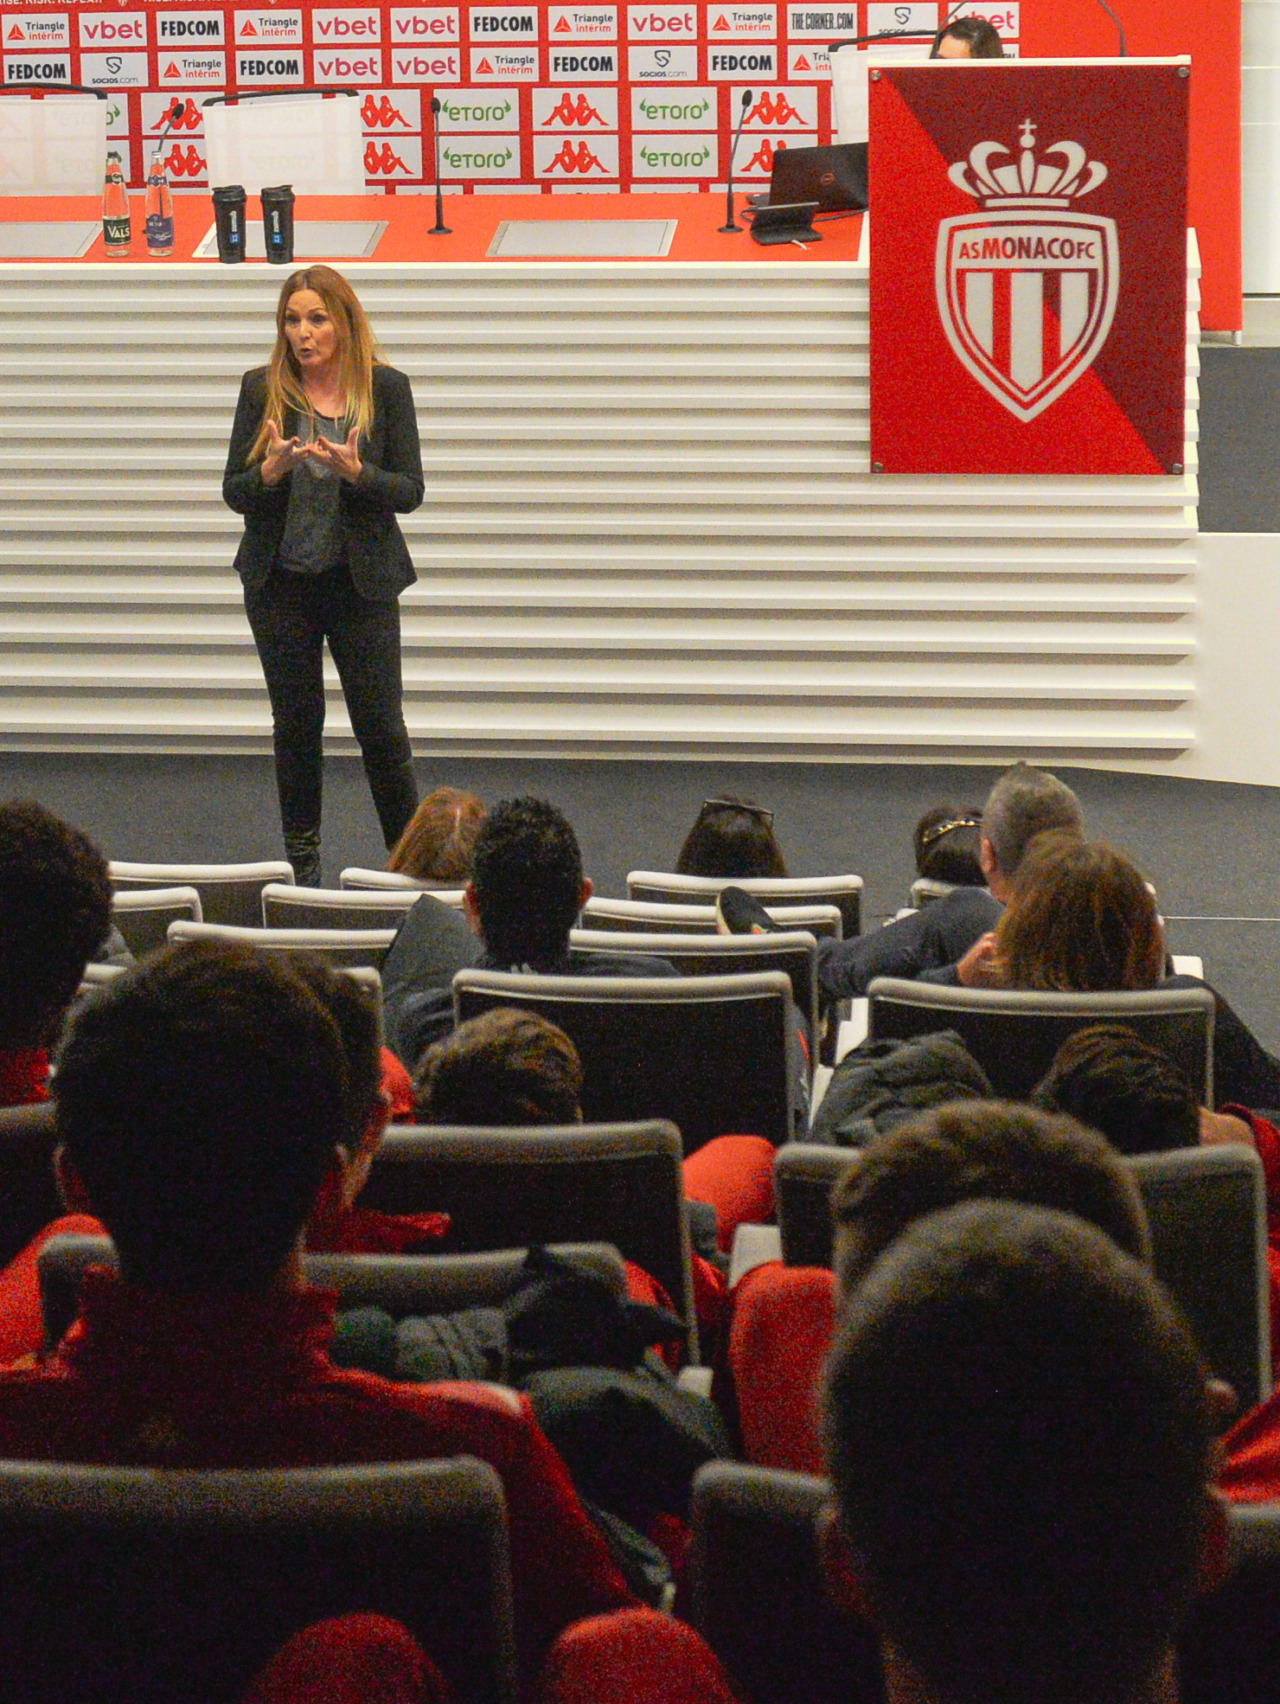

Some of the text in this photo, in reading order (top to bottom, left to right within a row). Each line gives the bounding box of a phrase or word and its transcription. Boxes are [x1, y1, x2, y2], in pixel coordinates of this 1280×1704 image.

[258, 18, 298, 28] Triangle
[317, 16, 376, 35] vbet
[396, 15, 455, 34] vbet
[474, 16, 533, 32] FEDCOM
[573, 14, 613, 25] Triangle
[633, 13, 693, 32] vbet
[732, 13, 772, 23] Triangle
[791, 13, 805, 31] THE
[26, 22, 65, 32] Triangle
[83, 20, 143, 39] vbet
[161, 20, 220, 36] FEDCOM
[262, 27, 296, 36] intérim
[577, 23, 611, 32] intérim
[736, 23, 770, 32] intérim
[29, 31, 63, 40] intérim
[182, 60, 221, 69] Triangle
[240, 59, 299, 76] FEDCOM
[318, 57, 378, 76] vbet
[397, 56, 456, 75] vbet
[495, 56, 534, 67] Triangle
[554, 56, 613, 72] FEDCOM
[712, 55, 772, 71] FEDCOM
[8, 64, 66, 79] FEDCOM
[186, 68, 220, 77] intérim
[498, 65, 532, 74] intérim
